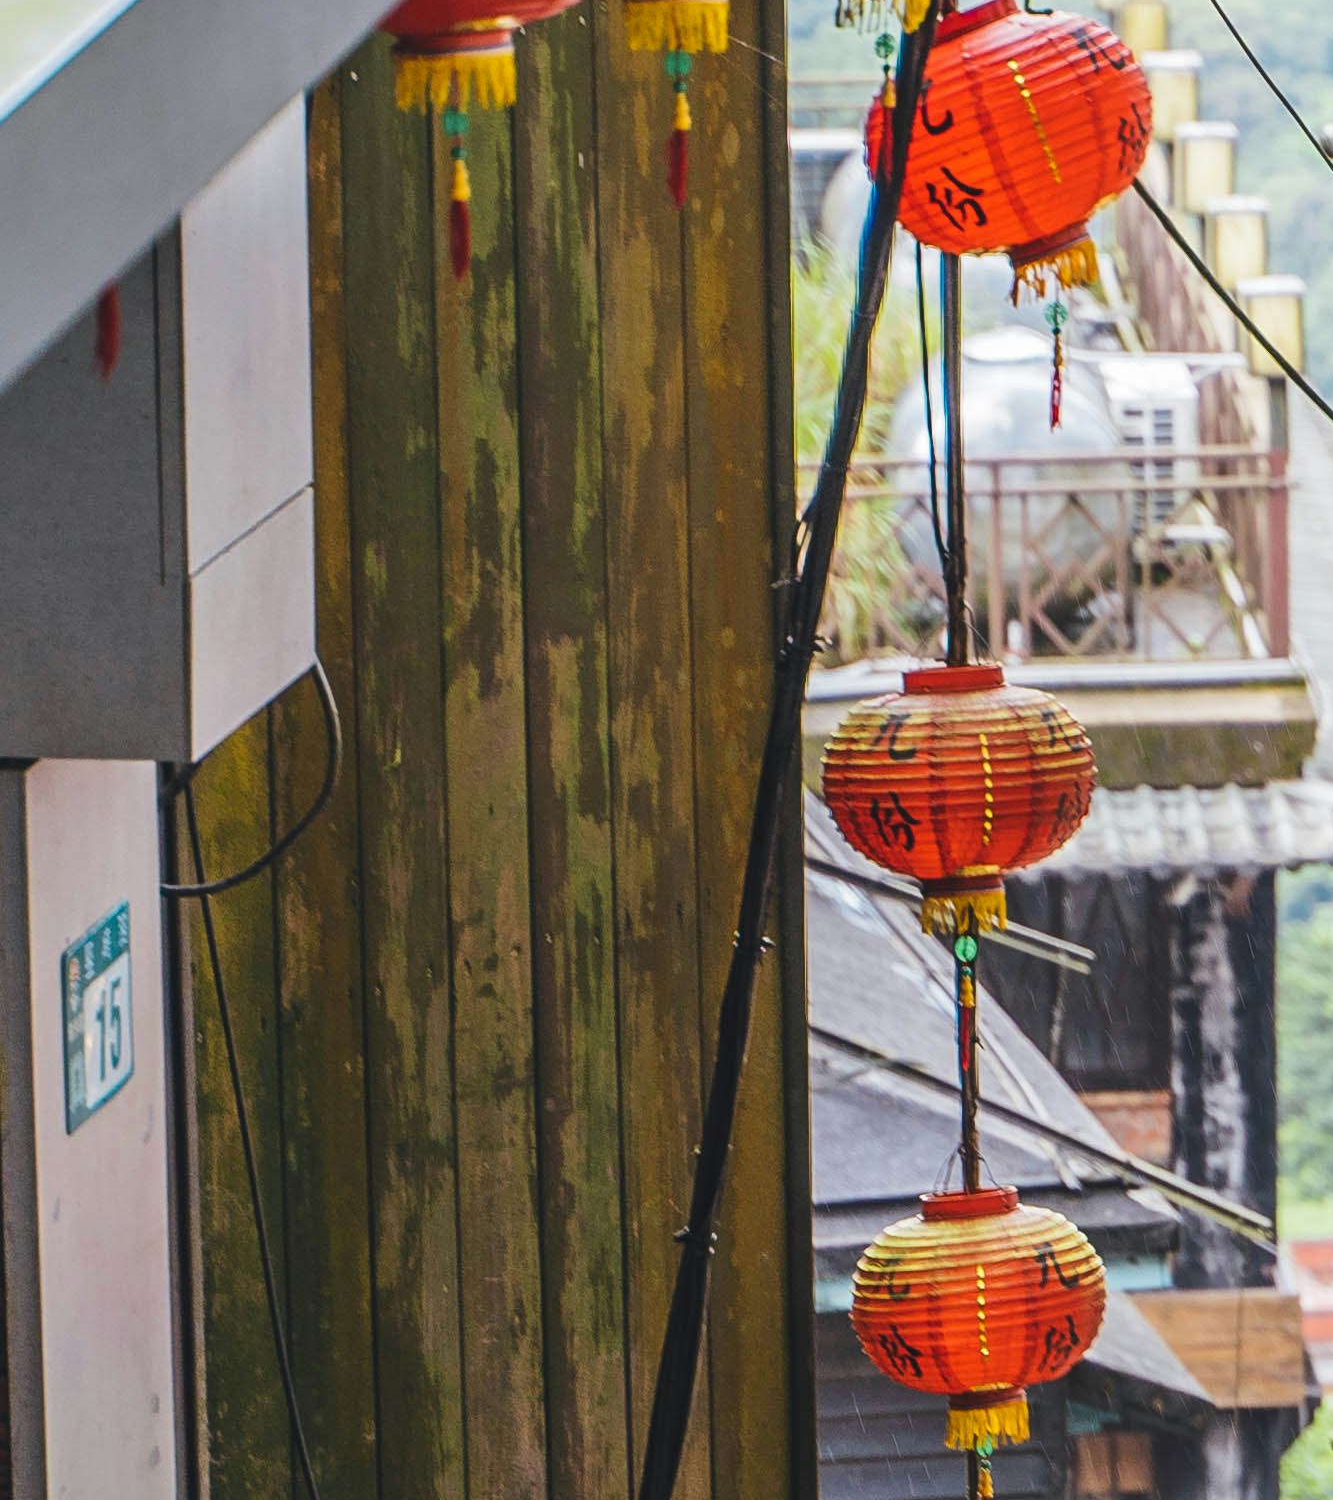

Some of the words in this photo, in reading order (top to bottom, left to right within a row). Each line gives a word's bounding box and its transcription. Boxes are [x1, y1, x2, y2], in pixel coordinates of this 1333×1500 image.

[870, 713, 921, 851] 九份
[96, 975, 122, 1082] 15
[1034, 1241, 1081, 1374] 九份
